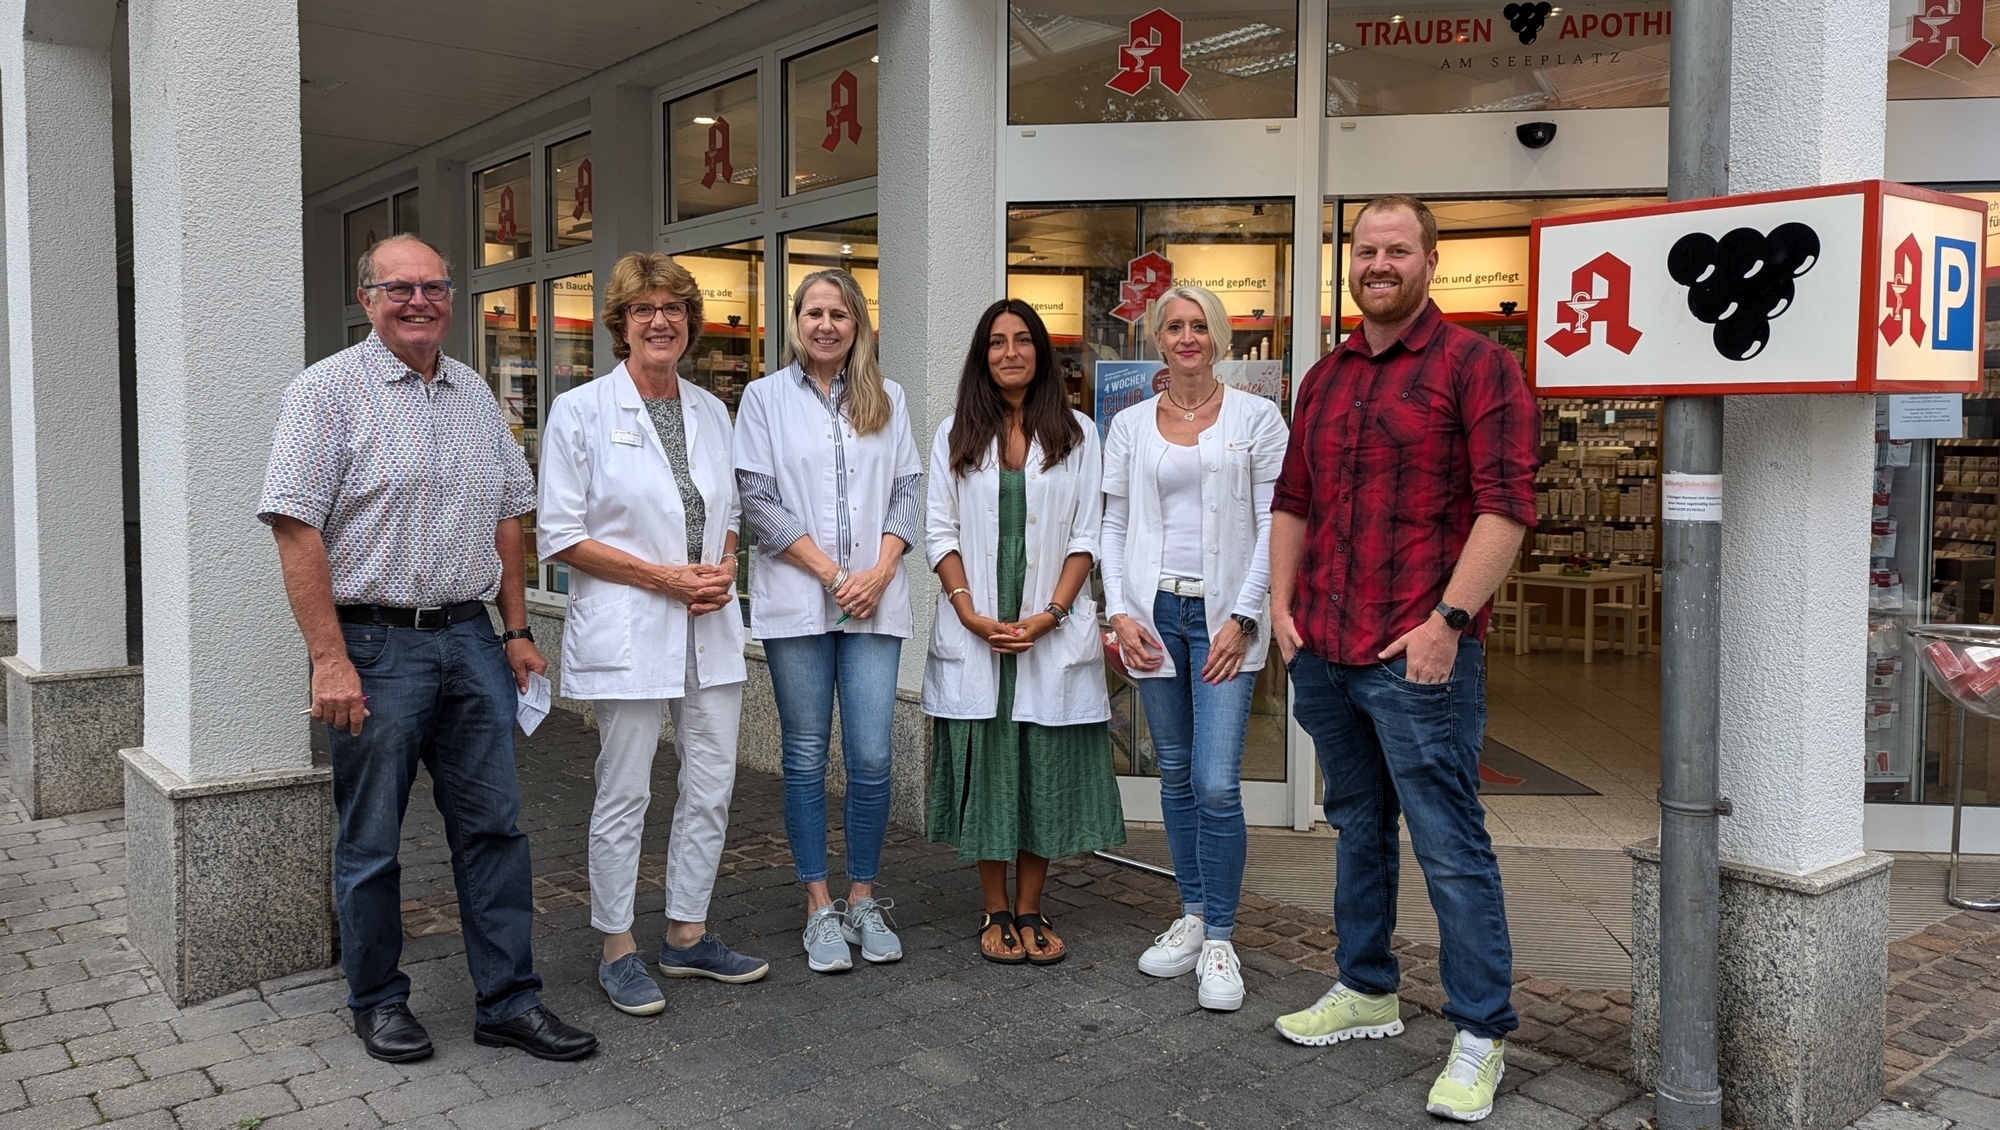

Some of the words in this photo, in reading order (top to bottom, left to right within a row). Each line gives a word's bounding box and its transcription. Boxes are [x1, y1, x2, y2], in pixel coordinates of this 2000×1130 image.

[1356, 18, 1492, 46] TRAUBEN
[1441, 57, 1472, 69] AM
[1491, 51, 1621, 68] SEEPLATZ
[1172, 277, 1202, 287] Schön
[1205, 277, 1224, 287] und
[1226, 277, 1267, 289] gepflegt
[1452, 273, 1472, 283] und
[1475, 272, 1519, 285] gepflegt
[566, 281, 593, 291] Bauch
[717, 288, 733, 298] ade
[1938, 246, 1970, 341] P
[1029, 302, 1064, 311] tgesund
[1104, 383, 1110, 394] 4
[1111, 373, 1147, 392] WOCHEN
